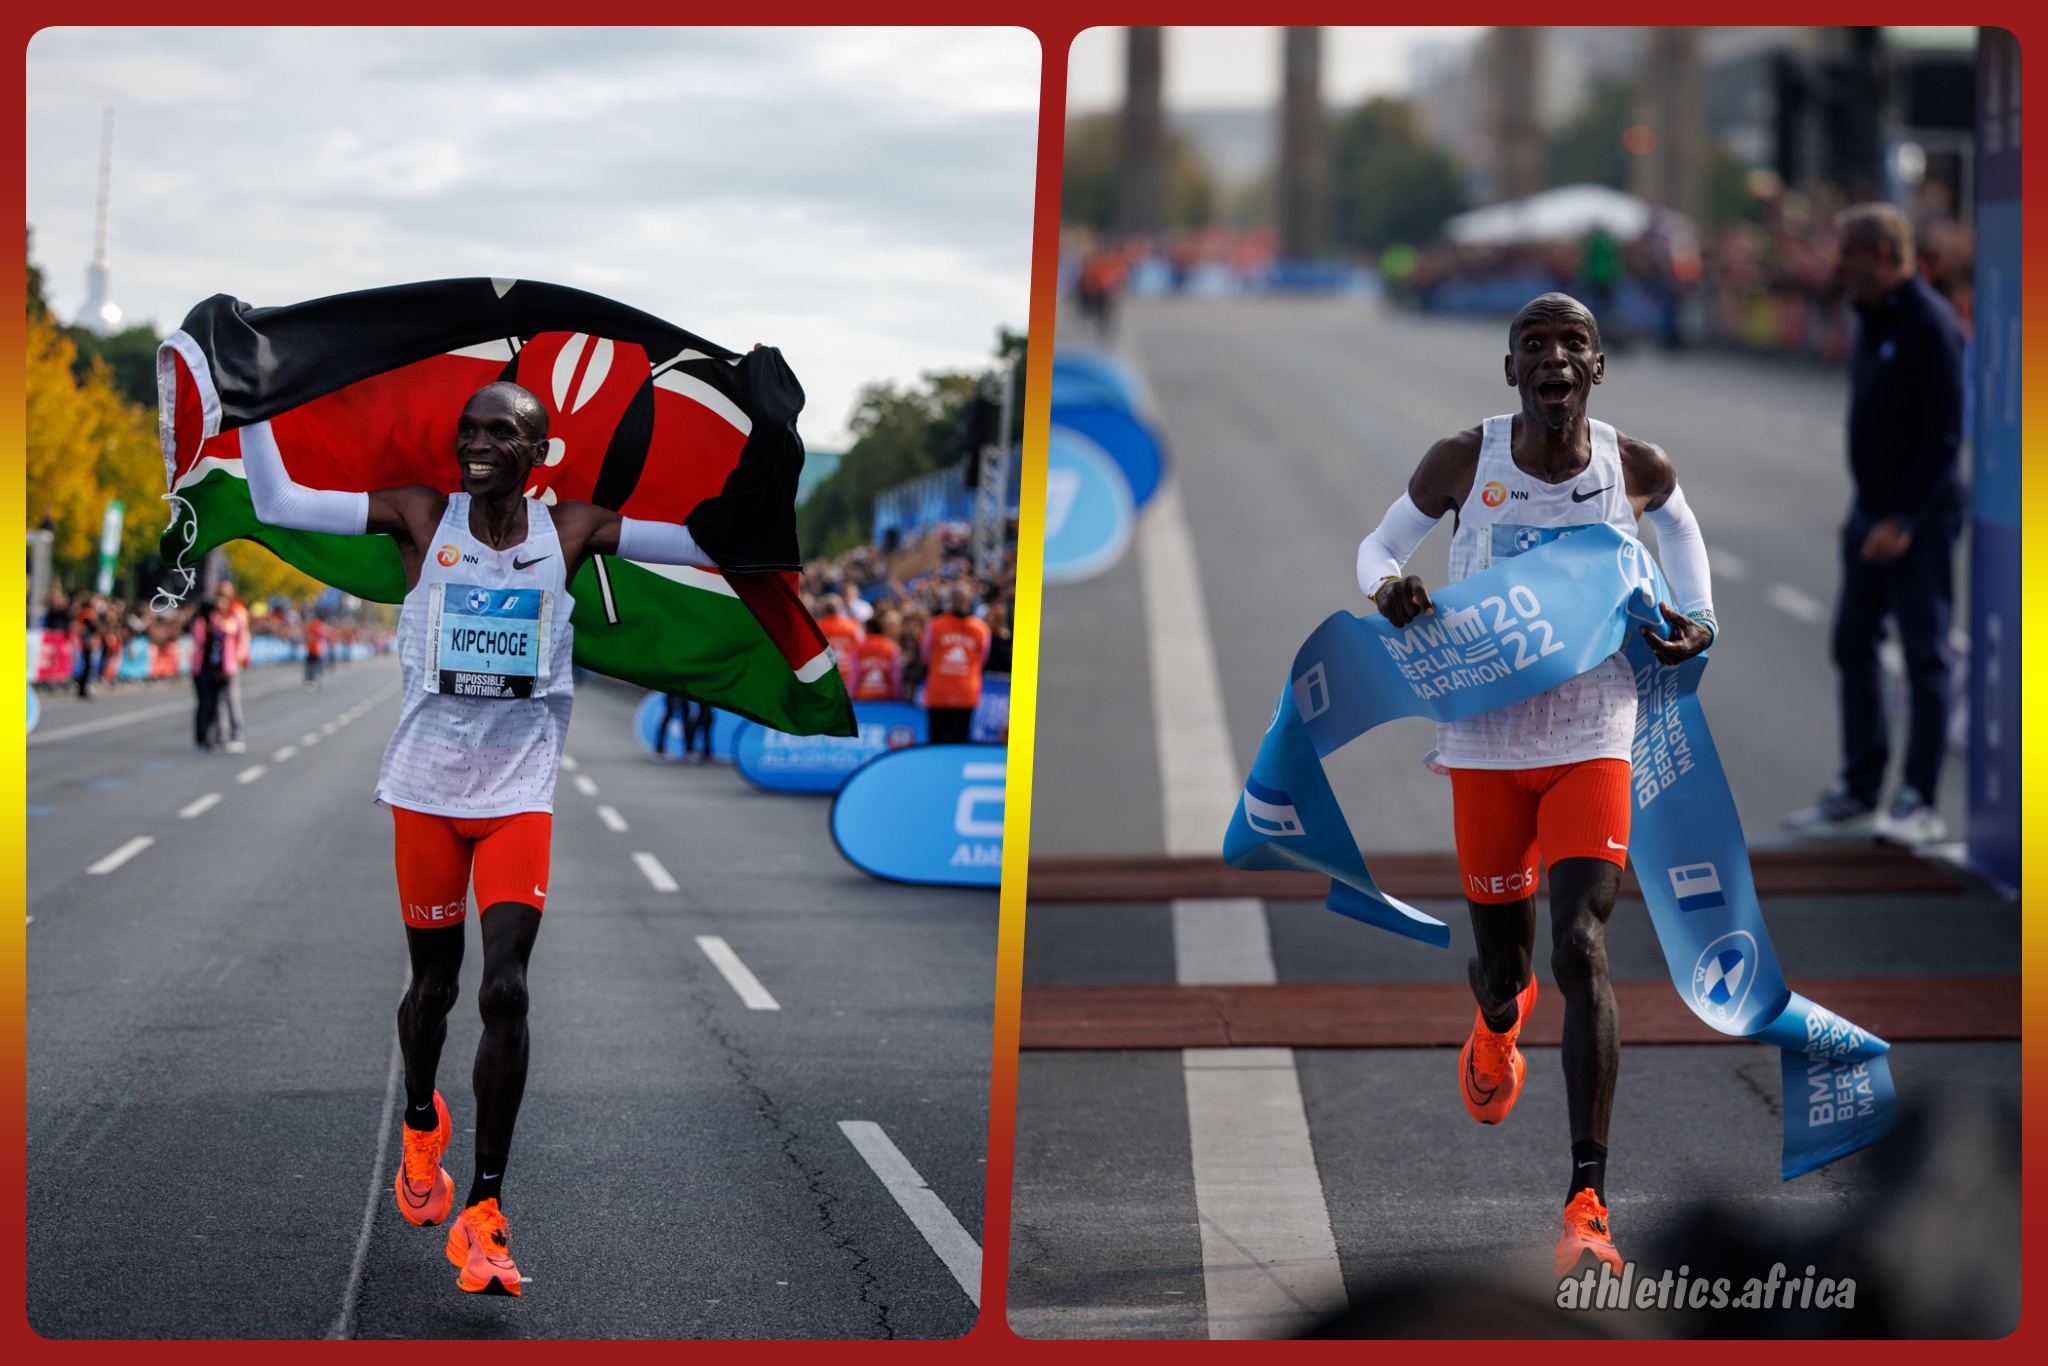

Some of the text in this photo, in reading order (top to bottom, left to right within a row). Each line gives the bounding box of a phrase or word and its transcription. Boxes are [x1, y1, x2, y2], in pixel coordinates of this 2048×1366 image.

[1510, 490, 1529, 501] NN
[462, 554, 479, 565] NN
[1480, 585, 1541, 634] 20
[451, 628, 528, 657] KIPCHOGE
[1378, 618, 1449, 662] BMW
[1501, 619, 1566, 671] 22
[455, 672, 506, 687] IMPOSSIBLE
[485, 660, 491, 668] 1
[1396, 647, 1463, 681] BERLIN
[1409, 657, 1513, 701] MARATHON
[454, 683, 464, 694] IS
[464, 684, 502, 697] NOTHING
[1664, 669, 1695, 776] MARATHON
[1650, 717, 1678, 790] BERLIN
[1632, 735, 1661, 810] BMW
[1468, 866, 1533, 894] INEOS
[409, 896, 466, 921] INEOS
